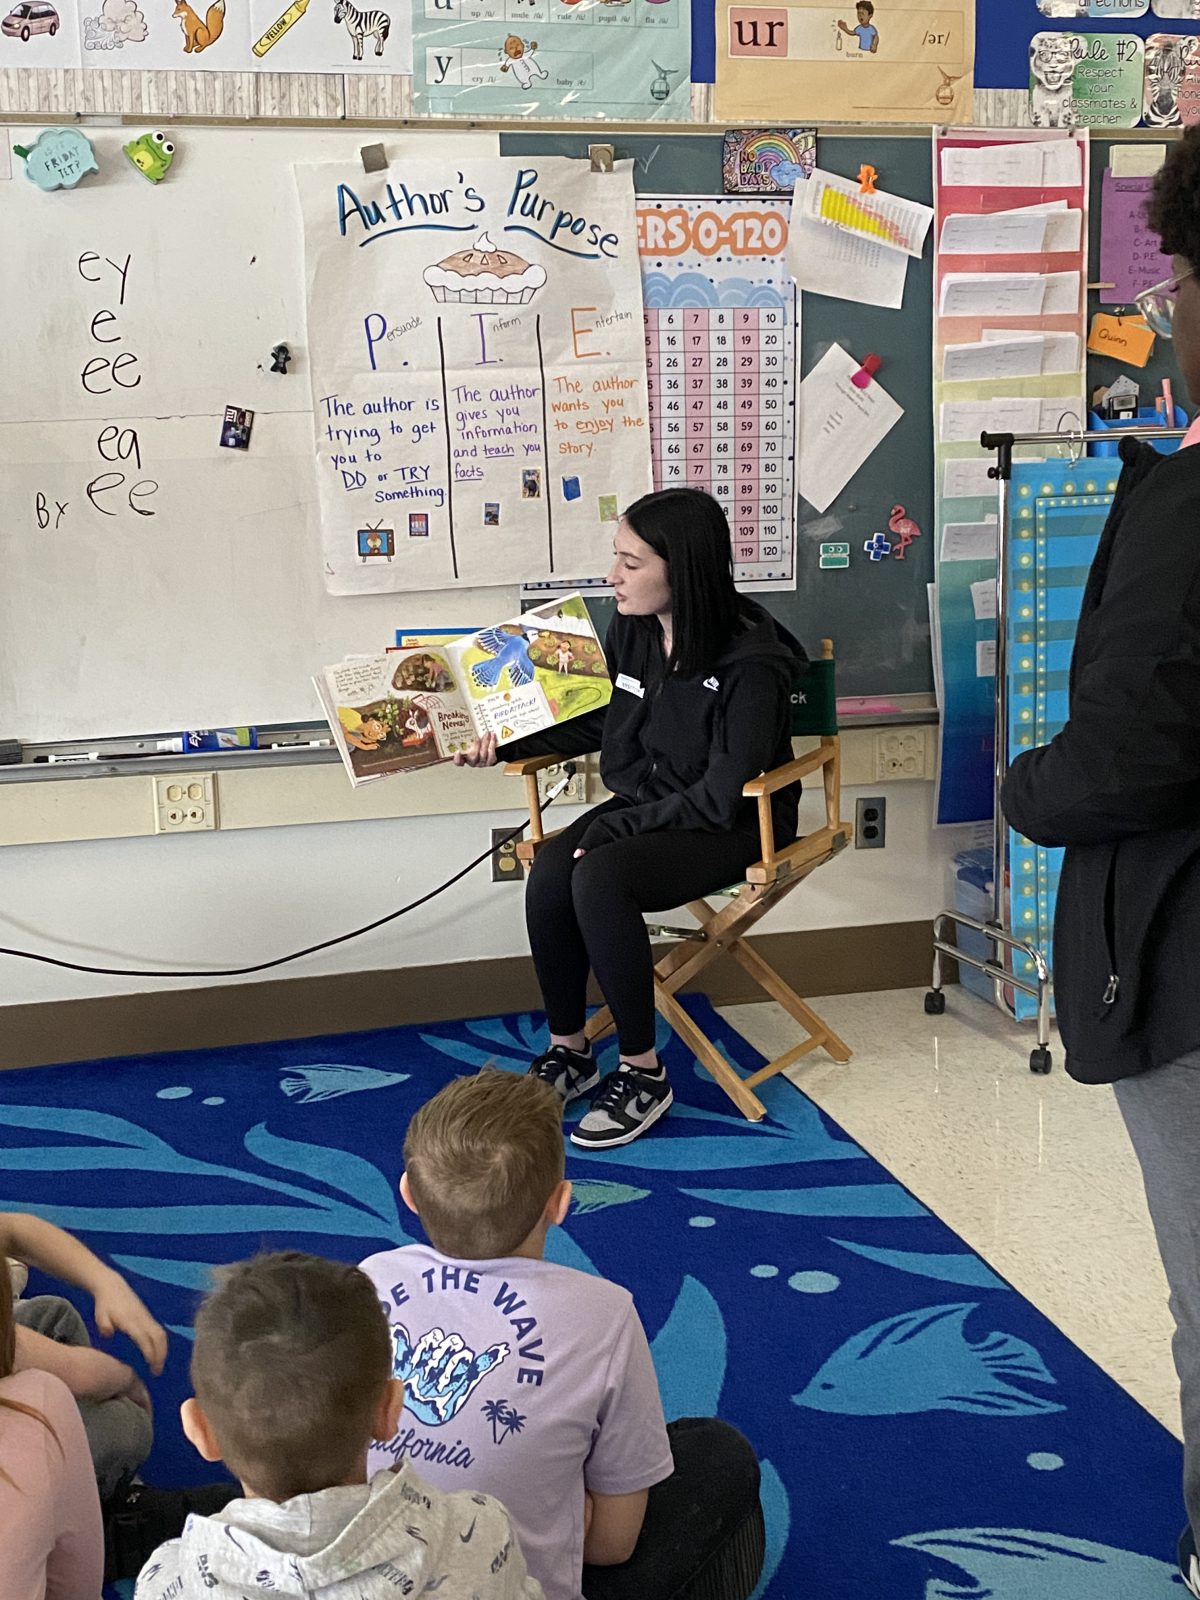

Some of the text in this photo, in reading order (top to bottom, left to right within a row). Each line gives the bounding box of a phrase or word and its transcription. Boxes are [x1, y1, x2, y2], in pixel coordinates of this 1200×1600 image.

[265, 18, 287, 41] YELLOW
[734, 20, 784, 47] ur
[1069, 38, 1138, 62] Rule #2
[434, 56, 453, 84] y
[1078, 66, 1124, 82] Respect
[1088, 84, 1114, 97] your
[1062, 98, 1137, 109] classmates &
[1078, 114, 1122, 124] teacher
[44, 146, 79, 171] FRIDAY
[740, 150, 757, 163] NO
[740, 162, 763, 174] BAD
[740, 174, 770, 186] DAYS
[337, 169, 618, 258] Author's Purpose
[697, 215, 785, 252] 0-120
[78, 251, 131, 305] ey
[91, 310, 122, 342] e
[765, 313, 777, 324] 10
[666, 335, 677, 346] 16
[692, 335, 702, 346] 17
[716, 335, 727, 346] 18
[741, 335, 752, 345] 19
[765, 334, 778, 345] 20
[1098, 329, 1127, 347] Quinn
[666, 357, 679, 368] 26
[691, 357, 703, 368] 27
[716, 357, 728, 367] 28
[740, 356, 753, 367] 29
[765, 356, 778, 367] 30
[81, 353, 141, 394] ee
[553, 376, 640, 393] The author
[666, 379, 679, 390] 36
[691, 379, 704, 389] 37
[716, 378, 729, 389] 38
[740, 378, 753, 389] 39
[764, 377, 778, 388] 40
[451, 385, 541, 404] The author
[320, 394, 440, 418] The author is
[551, 398, 624, 415] wants you
[666, 401, 680, 411] 46
[692, 400, 704, 410] 47
[716, 400, 729, 410] 48
[740, 399, 753, 410] 49
[765, 399, 778, 410] 50
[456, 406, 520, 431] gives you
[553, 414, 645, 434] to enjoy the
[667, 420, 777, 433] 56 57 58 59 60
[326, 421, 437, 446] trying to get
[461, 422, 538, 441] information
[453, 442, 541, 458] and teach you
[667, 441, 777, 454] 66 67 68 69 70
[330, 448, 382, 470] you to
[341, 465, 431, 489] DO or TRY
[668, 463, 777, 476] 76 77 78 79 80
[716, 485, 729, 496] 88
[741, 484, 753, 495] 89
[764, 483, 777, 494] 90
[740, 505, 753, 515] 99
[762, 504, 778, 515] 100
[739, 525, 777, 536] 109 110
[740, 546, 778, 557] 119 120
[790, 692, 807, 704] ck
[422, 1266, 484, 1294] THE
[493, 1281, 545, 1387] WAVE
